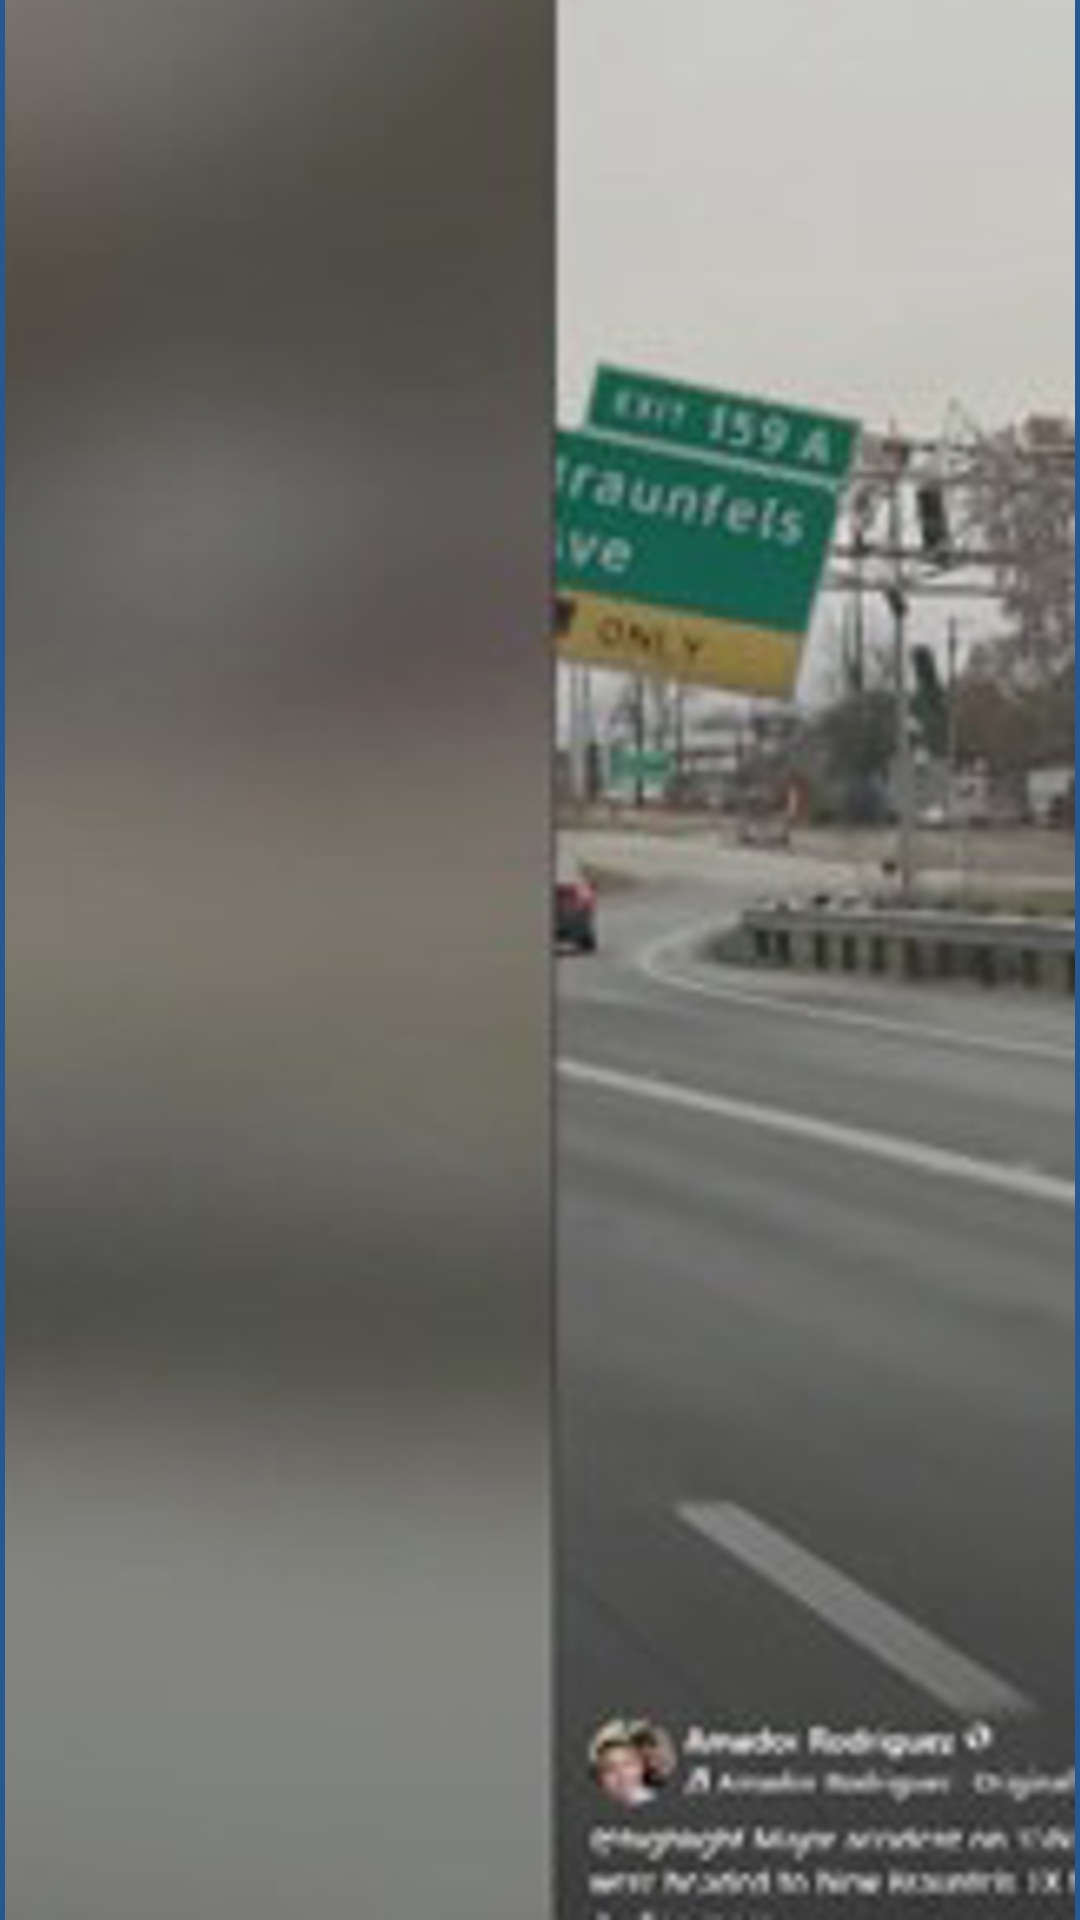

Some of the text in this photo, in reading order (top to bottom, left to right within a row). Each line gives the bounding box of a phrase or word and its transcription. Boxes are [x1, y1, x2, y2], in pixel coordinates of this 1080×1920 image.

[613, 390, 830, 464] EXIT 159 A
[557, 456, 804, 546] raunfels
[557, 528, 632, 574] ve
[597, 616, 703, 656] ONLY
